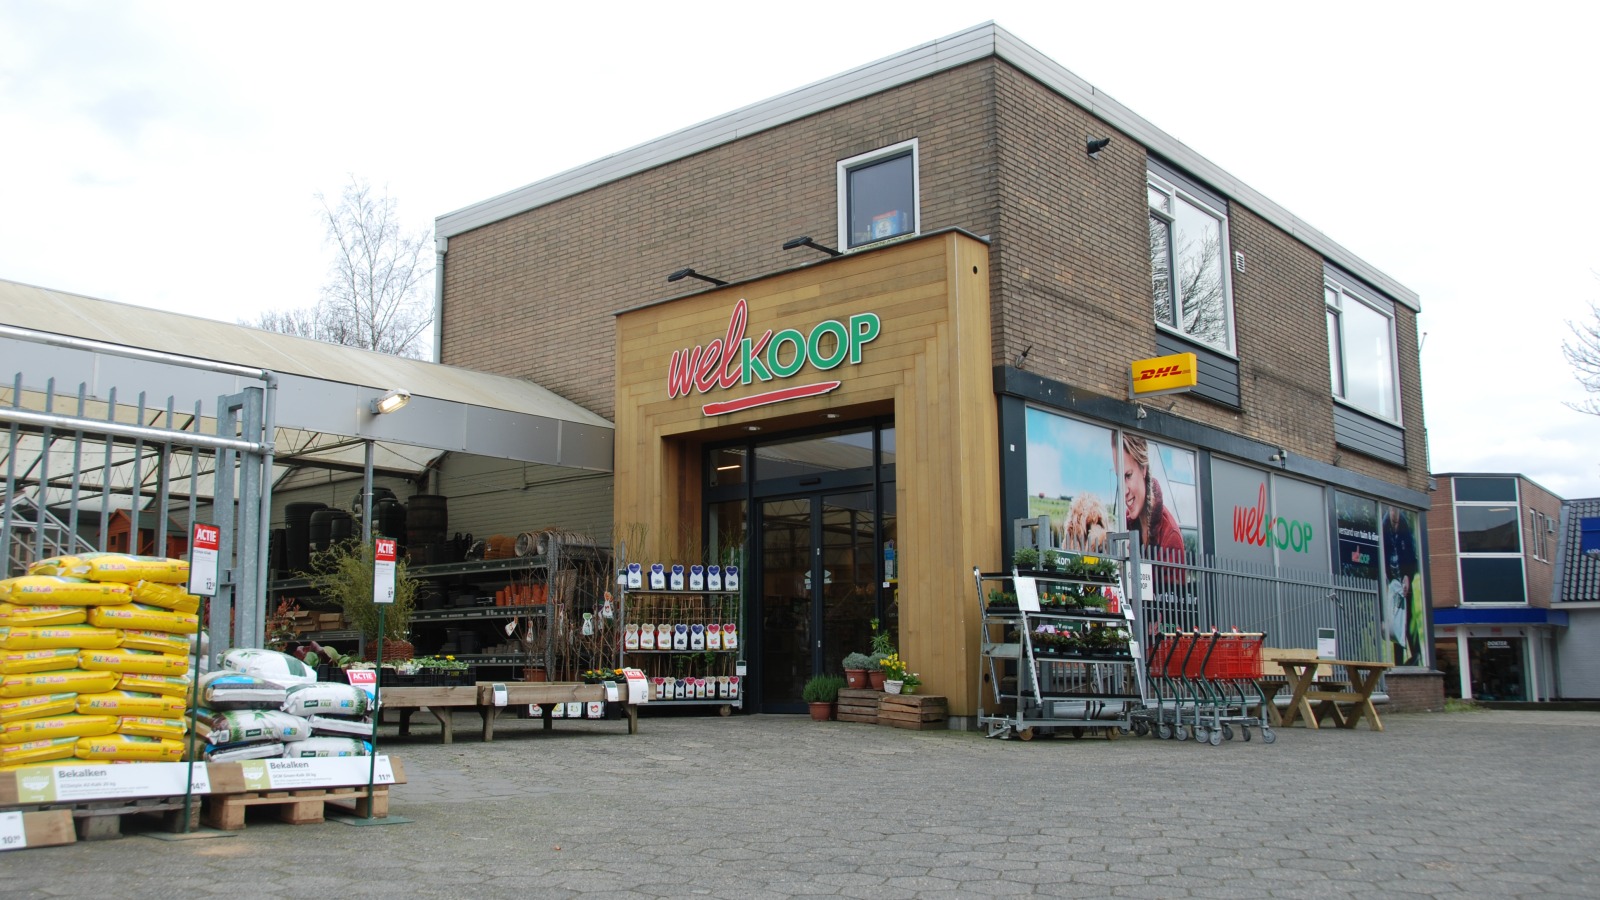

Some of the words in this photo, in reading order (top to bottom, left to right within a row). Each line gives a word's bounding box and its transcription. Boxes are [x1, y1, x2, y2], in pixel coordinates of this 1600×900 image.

[1141, 365, 1182, 380] DHL
[196, 528, 217, 543] ACTIE
[377, 542, 394, 555] ACTIE
[353, 672, 374, 680] ACTIE
[270, 761, 309, 769] Bekalken
[58, 769, 107, 778] Bekalken
